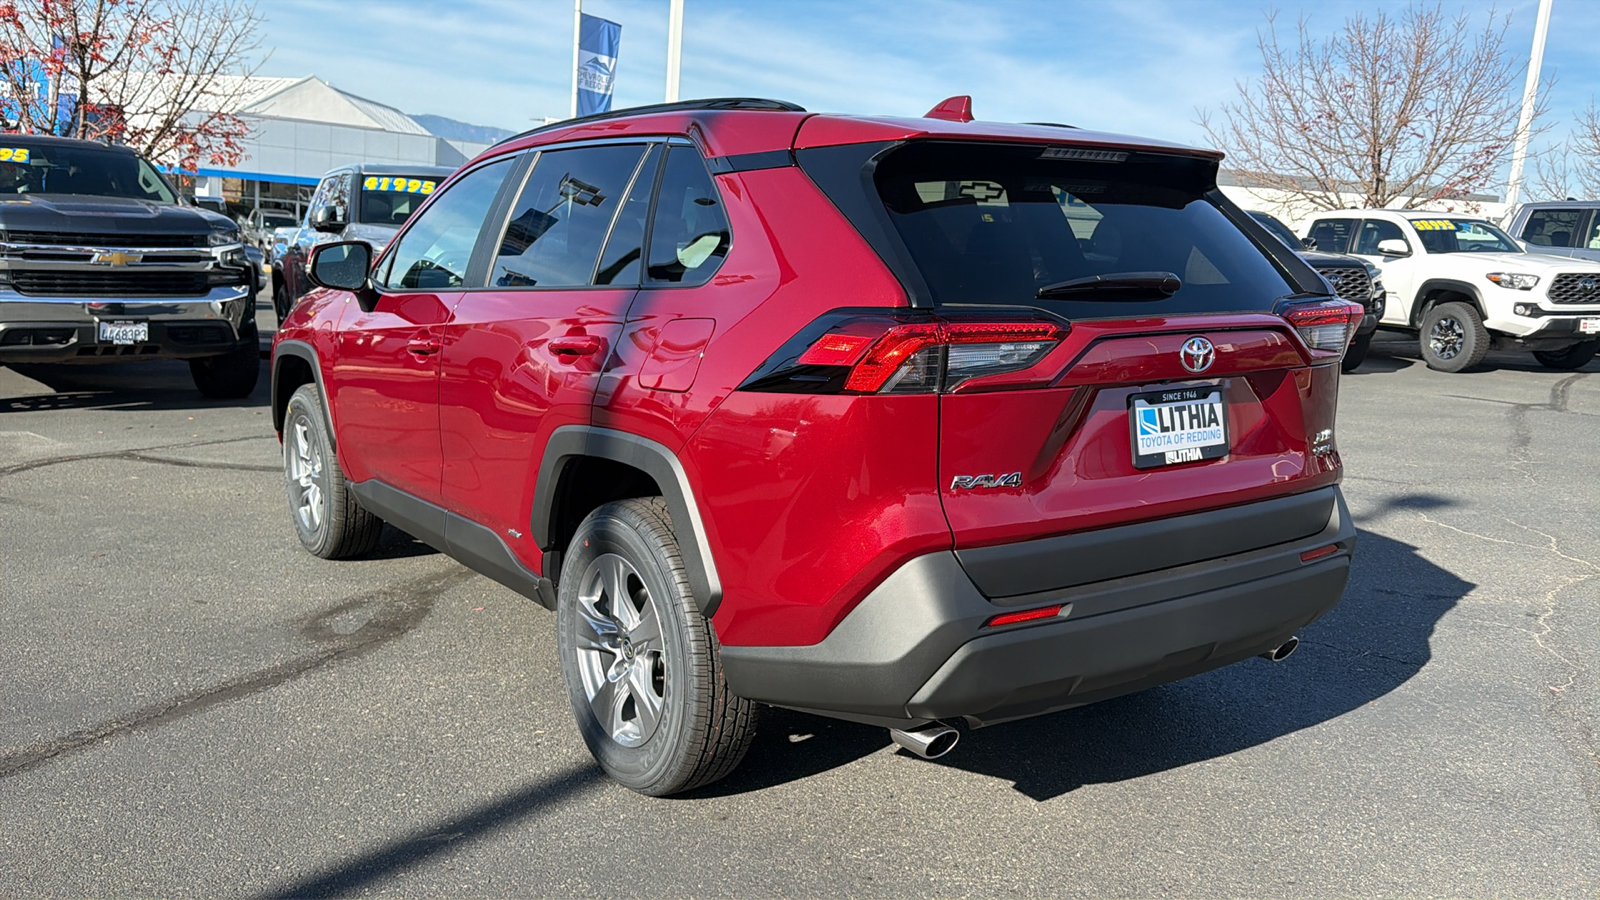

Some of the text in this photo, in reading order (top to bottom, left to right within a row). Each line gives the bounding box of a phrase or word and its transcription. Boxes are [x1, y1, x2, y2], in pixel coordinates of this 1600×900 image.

[578, 71, 612, 84] HEVROLE
[0, 148, 29, 162] 95
[364, 177, 436, 194] 41995
[1162, 391, 1197, 401] SINCE 1946
[1157, 402, 1220, 433] LITHIA
[1140, 429, 1221, 448] TOYOTA OF REDDING
[1174, 447, 1203, 463] LITHIA
[950, 471, 1022, 489] RAV4
